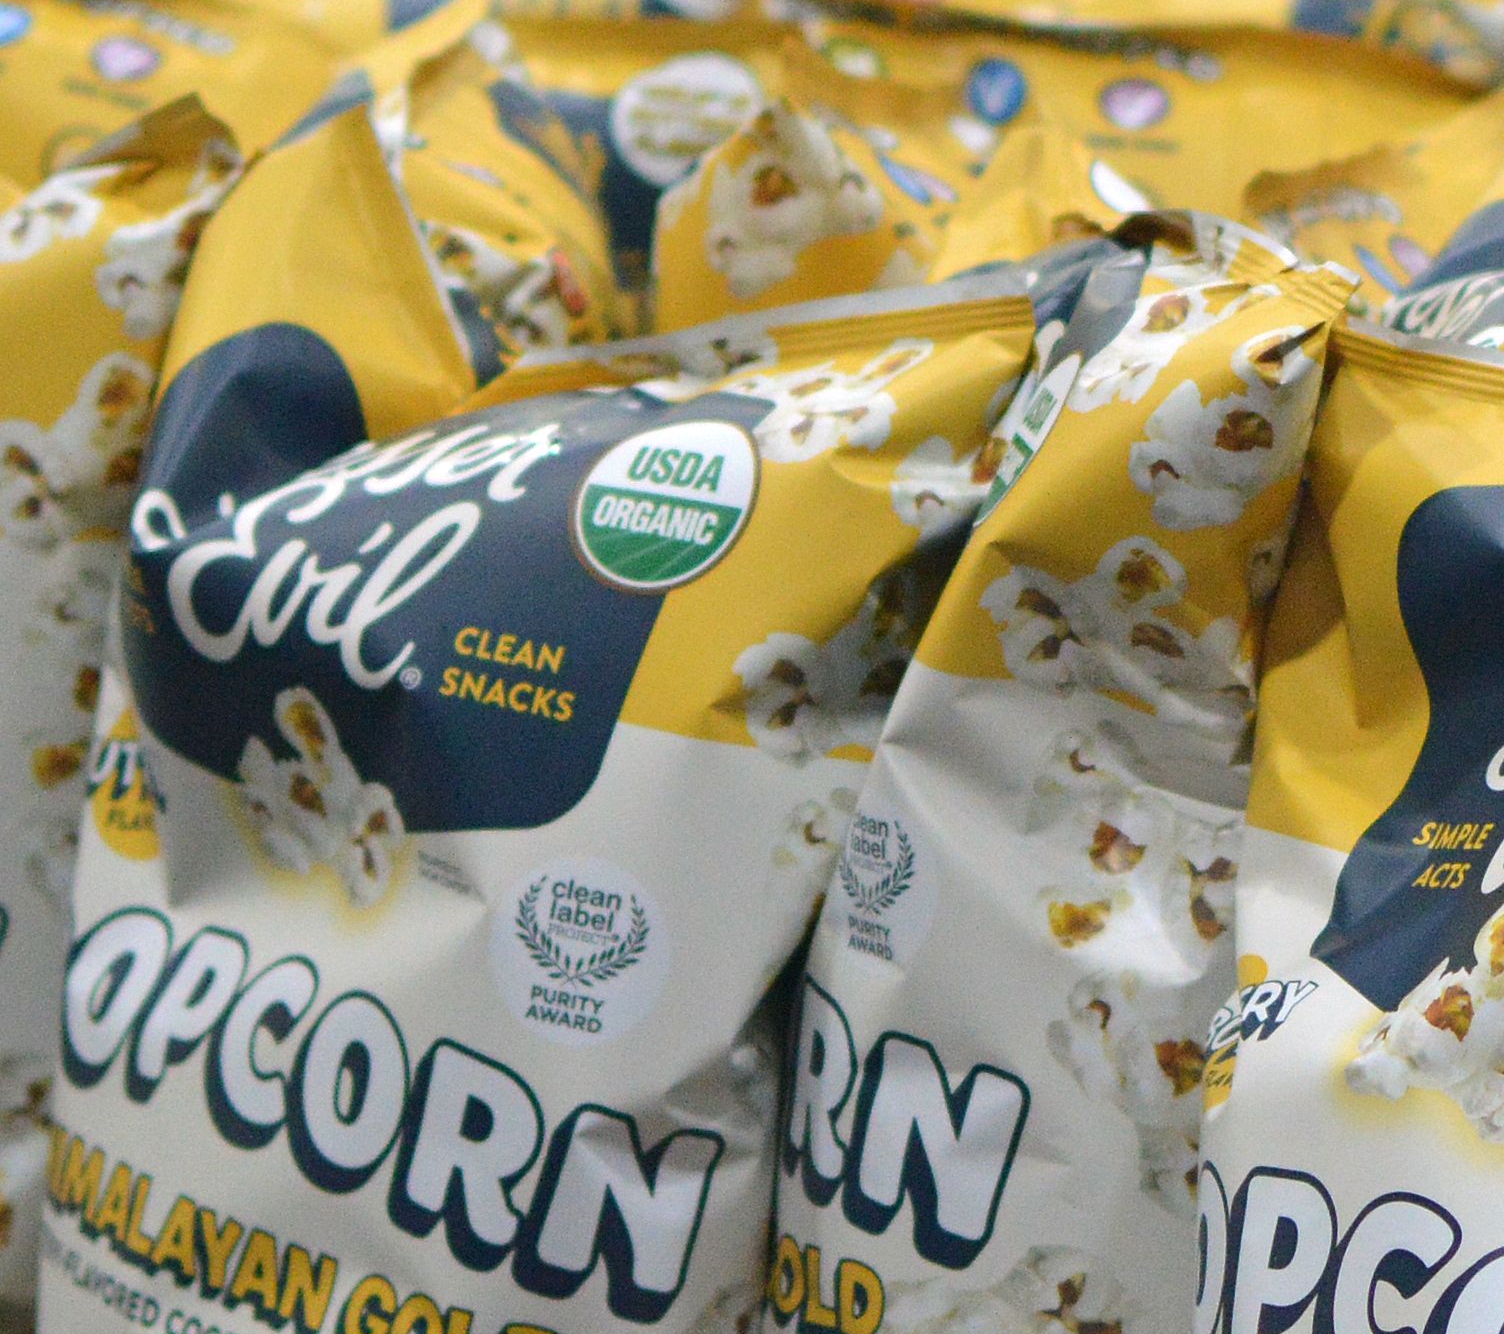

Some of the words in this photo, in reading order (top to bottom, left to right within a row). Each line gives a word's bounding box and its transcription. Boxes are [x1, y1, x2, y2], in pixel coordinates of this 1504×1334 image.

[627, 445, 725, 494] USDA
[592, 493, 722, 547] ORGANIC
[168, 500, 483, 691] Evil
[453, 626, 566, 676] CLEAN
[437, 666, 577, 723] SNACKS
[1411, 820, 1495, 852] SIMPLE
[1411, 861, 1469, 890] ACTS
[551, 878, 623, 912] clean
[548, 899, 616, 934] label
[847, 915, 891, 941] PURITY
[847, 934, 893, 961] AWARD
[529, 984, 605, 1014] PURITY
[525, 1005, 603, 1034] AWARD
[58, 904, 725, 1325] OPCORN
